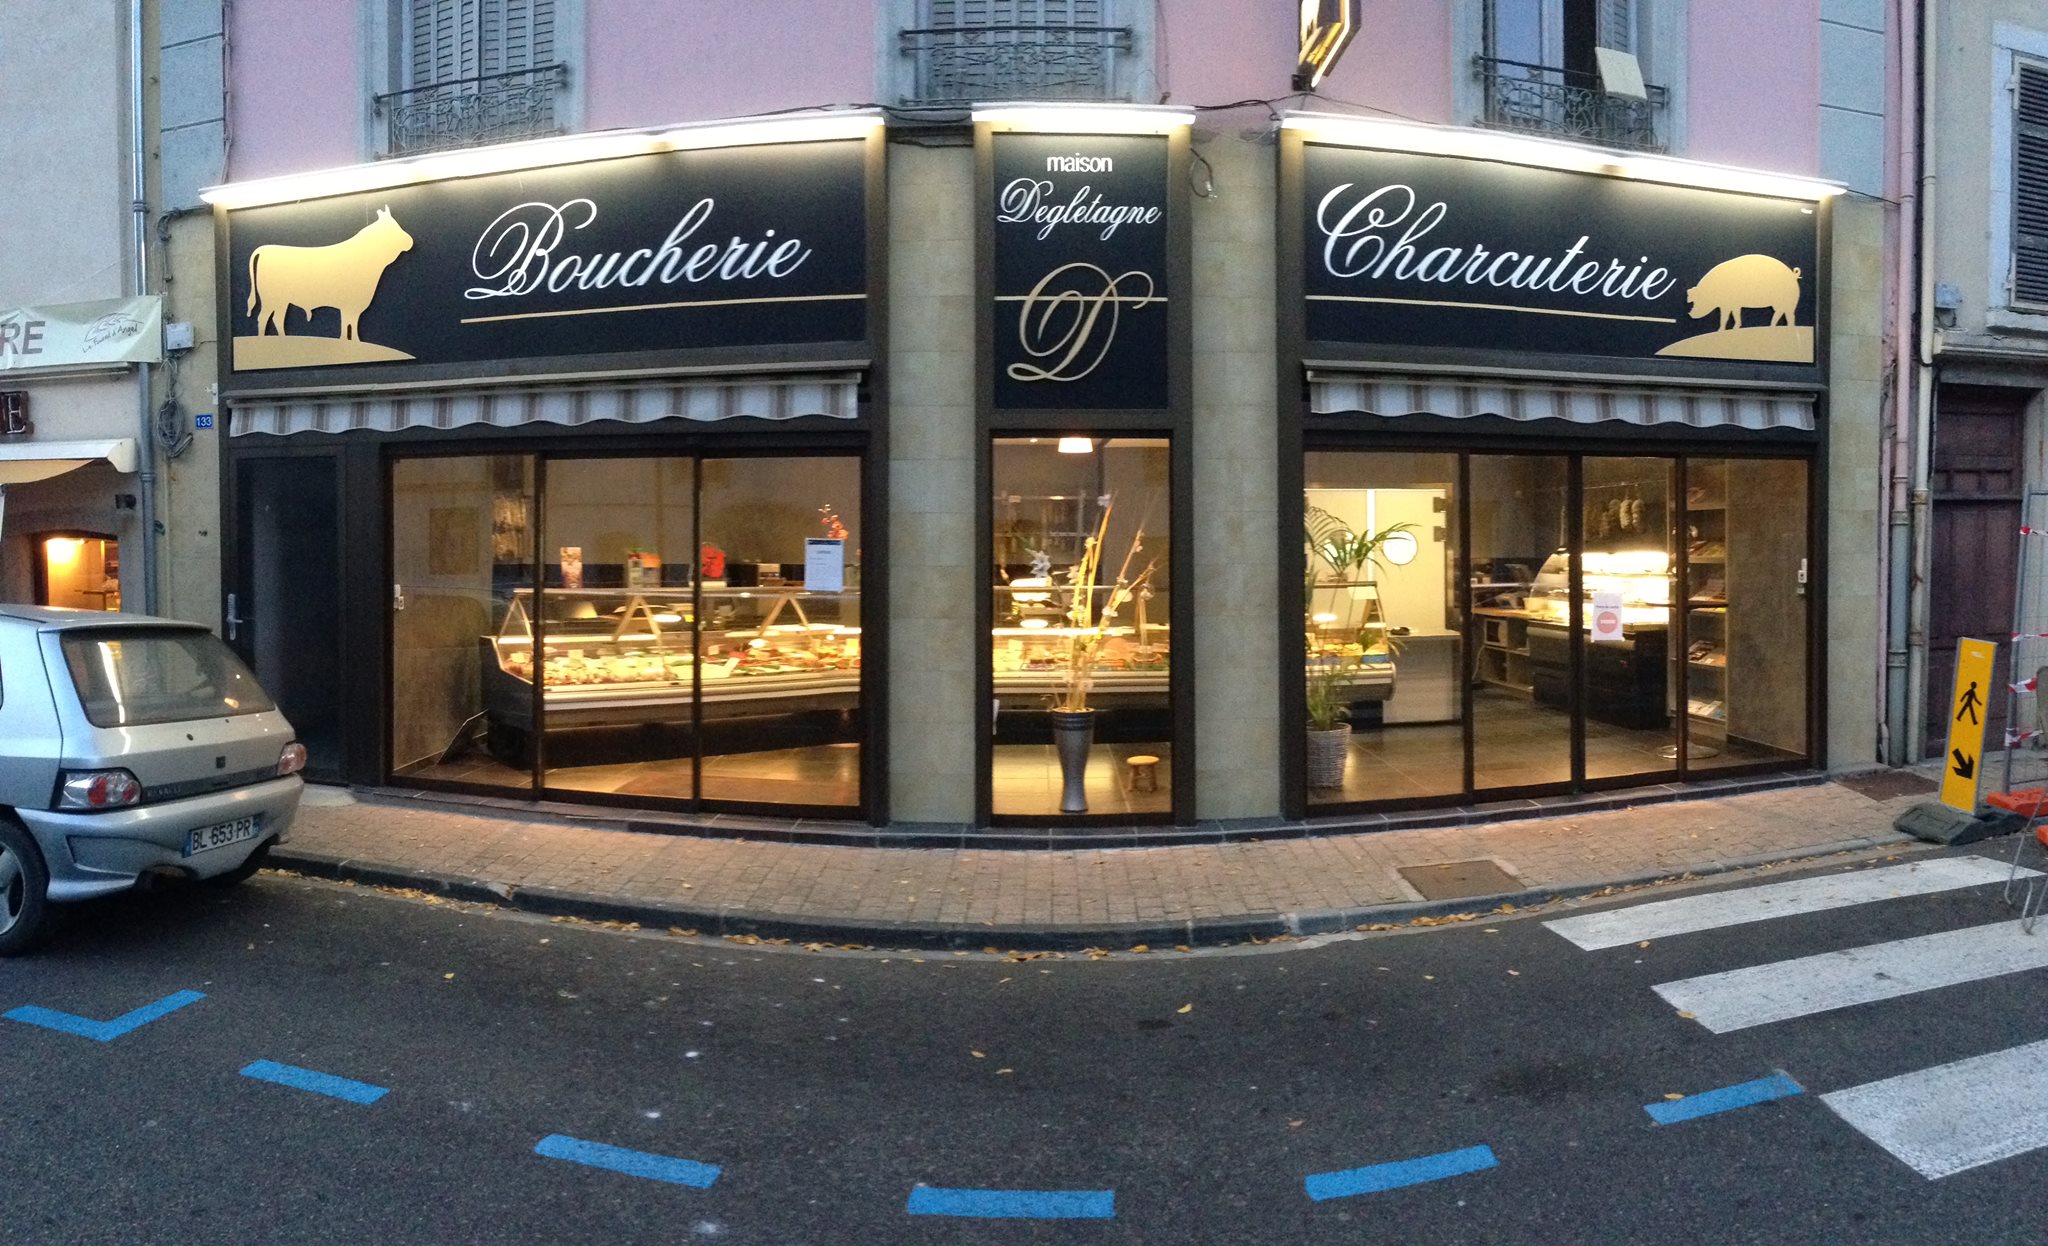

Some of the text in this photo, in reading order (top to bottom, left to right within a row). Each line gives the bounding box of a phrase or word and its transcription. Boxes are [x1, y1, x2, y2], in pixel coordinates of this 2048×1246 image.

[1046, 153, 1113, 173] maison
[464, 198, 812, 300] Boucherie
[996, 177, 1162, 241] Degletagne
[1316, 183, 1677, 300] Charcuterie
[1007, 262, 1154, 382] D
[196, 416, 212, 427] 133
